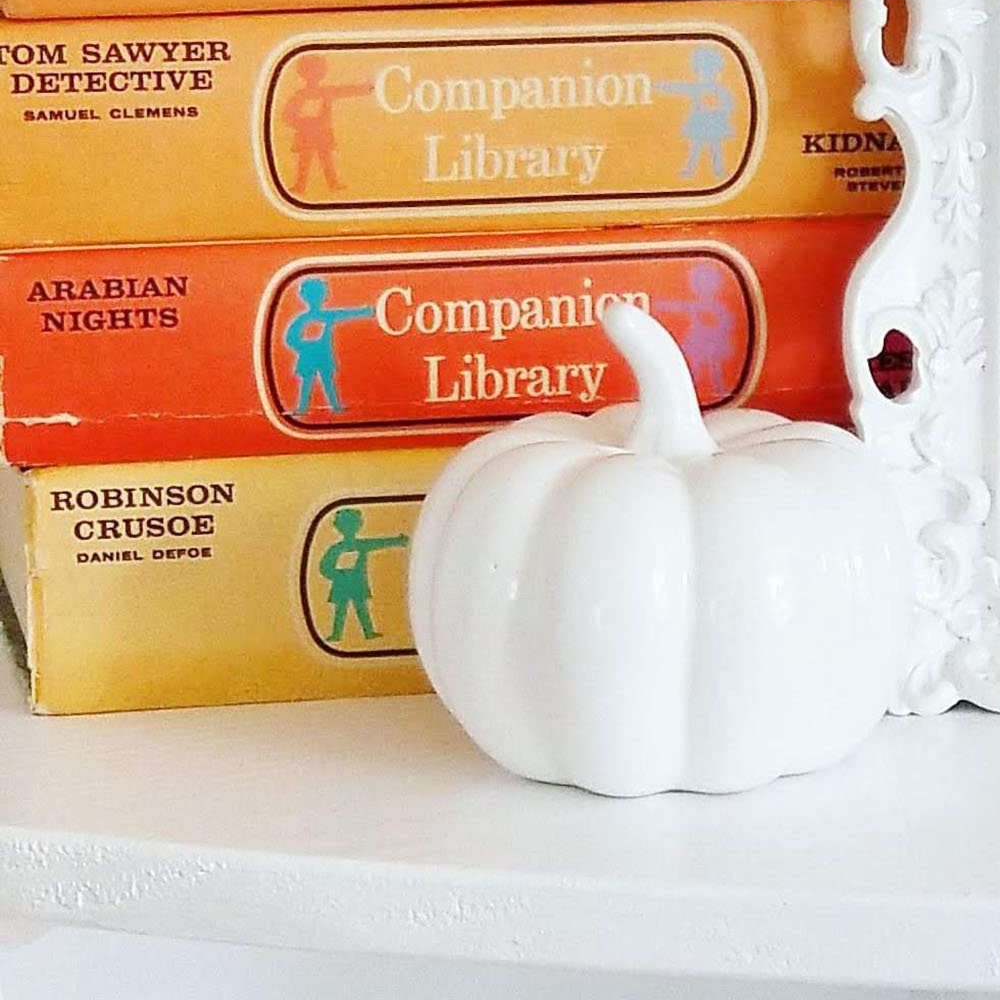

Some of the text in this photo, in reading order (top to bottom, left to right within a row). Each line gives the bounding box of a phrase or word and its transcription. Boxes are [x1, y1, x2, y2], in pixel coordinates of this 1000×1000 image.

[0, 41, 231, 66] TOM SAWYER
[10, 70, 213, 95] DETECTIVE
[373, 58, 653, 120] Companion
[23, 105, 199, 122] SAMUEL CLEMENS
[801, 132, 903, 154] KIDNA
[423, 132, 607, 184] Library
[834, 165, 905, 179] ROBERT
[847, 180, 905, 193] STEVE
[27, 276, 189, 301] ARABIAN
[40, 307, 180, 333] NIGHTS
[423, 353, 608, 404] Library
[50, 483, 235, 513] ROBINSON
[73, 514, 215, 541] CRUSOE
[76, 547, 213, 564] DANIEL DEFOE
